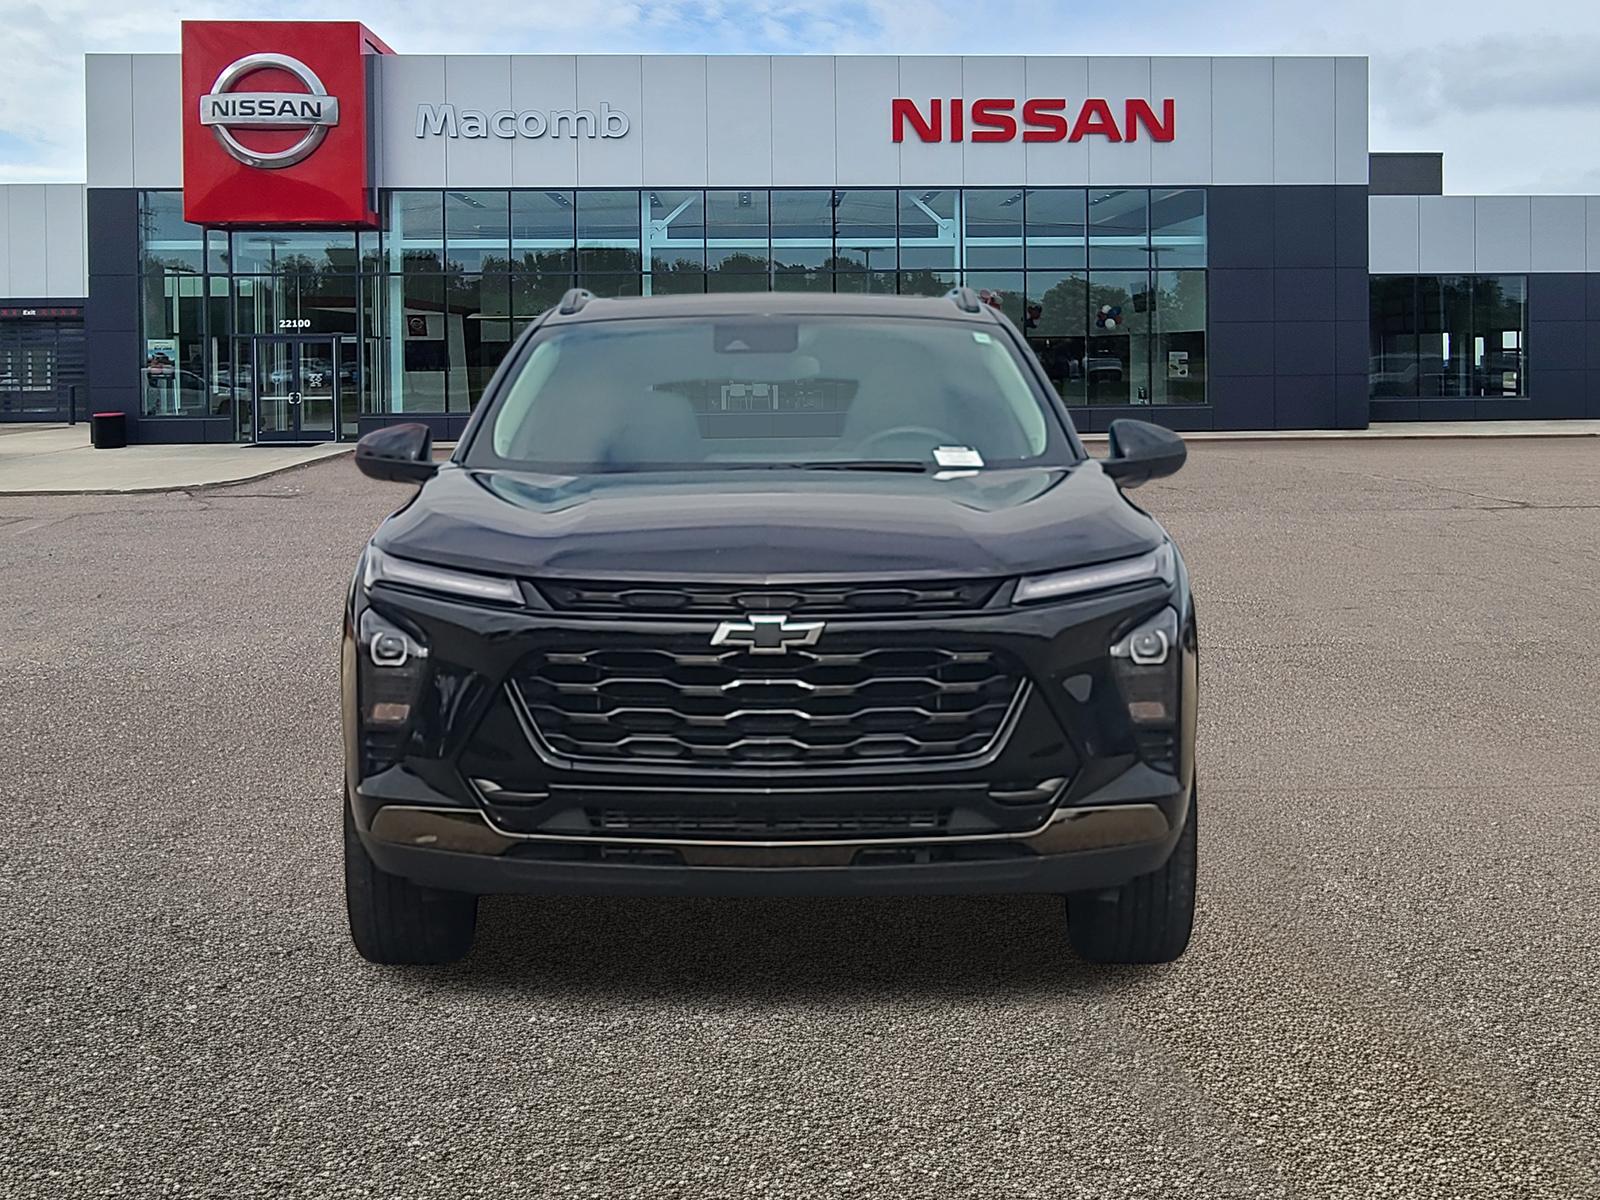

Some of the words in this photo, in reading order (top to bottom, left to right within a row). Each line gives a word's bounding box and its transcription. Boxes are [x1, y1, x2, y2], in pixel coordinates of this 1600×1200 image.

[212, 100, 322, 118] NISSAN
[415, 102, 630, 139] Macomb
[892, 98, 1175, 143] NISSAN
[279, 319, 311, 328] 22100
